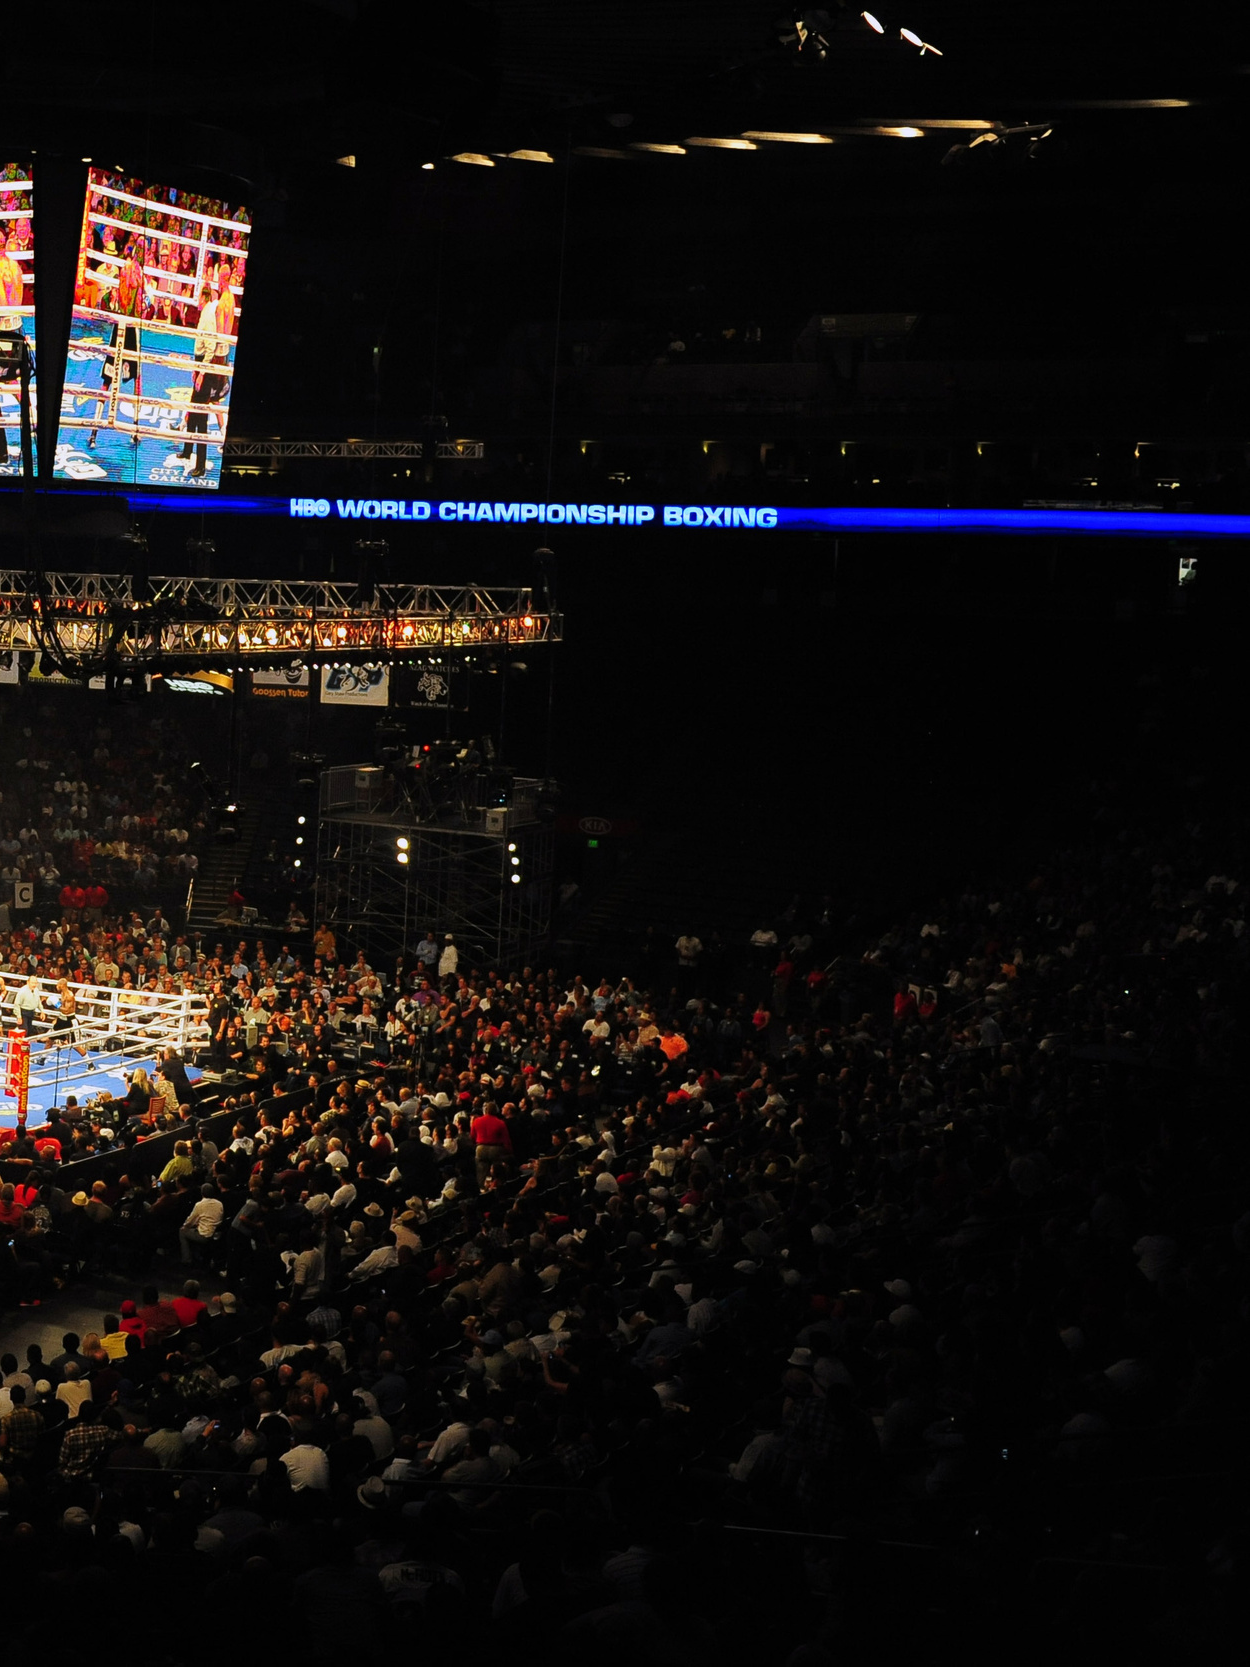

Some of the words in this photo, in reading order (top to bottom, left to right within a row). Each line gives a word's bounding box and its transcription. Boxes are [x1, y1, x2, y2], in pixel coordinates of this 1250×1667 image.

[151, 467, 182, 476] CITY
[148, 473, 218, 488] OAKLAND
[290, 498, 330, 518] HBO
[337, 500, 431, 521] WORLD
[438, 502, 655, 526] CHAMPIONSHIP
[663, 506, 778, 528] BOXING
[252, 687, 286, 698] Goossen
[288, 688, 309, 697] Tutor
[19, 887, 30, 902] C
